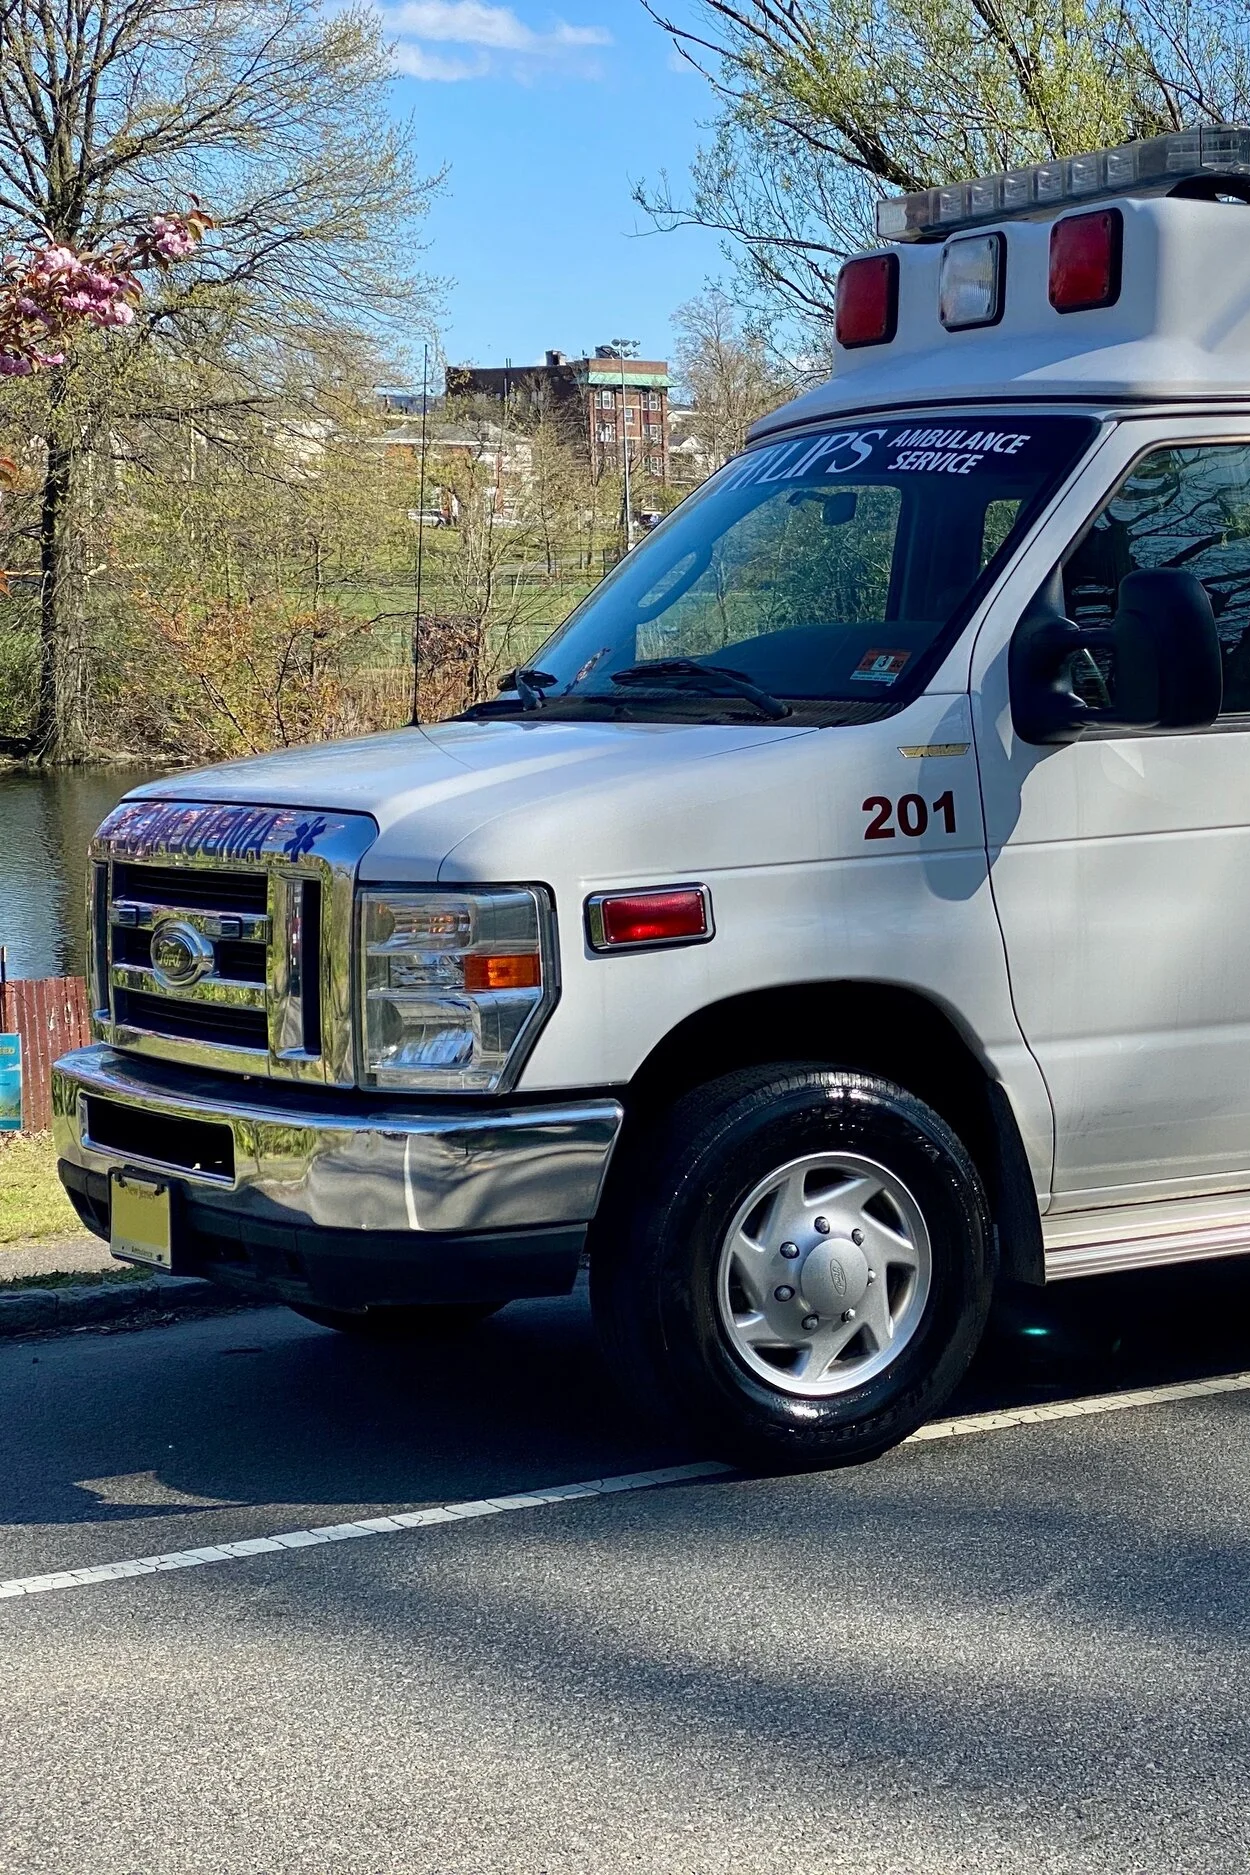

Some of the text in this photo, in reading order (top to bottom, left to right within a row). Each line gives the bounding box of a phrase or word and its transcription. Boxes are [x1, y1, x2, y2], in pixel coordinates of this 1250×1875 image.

[888, 429, 1031, 456] AMBULANCE
[887, 451, 984, 475] SERVICE
[862, 790, 957, 841] 201
